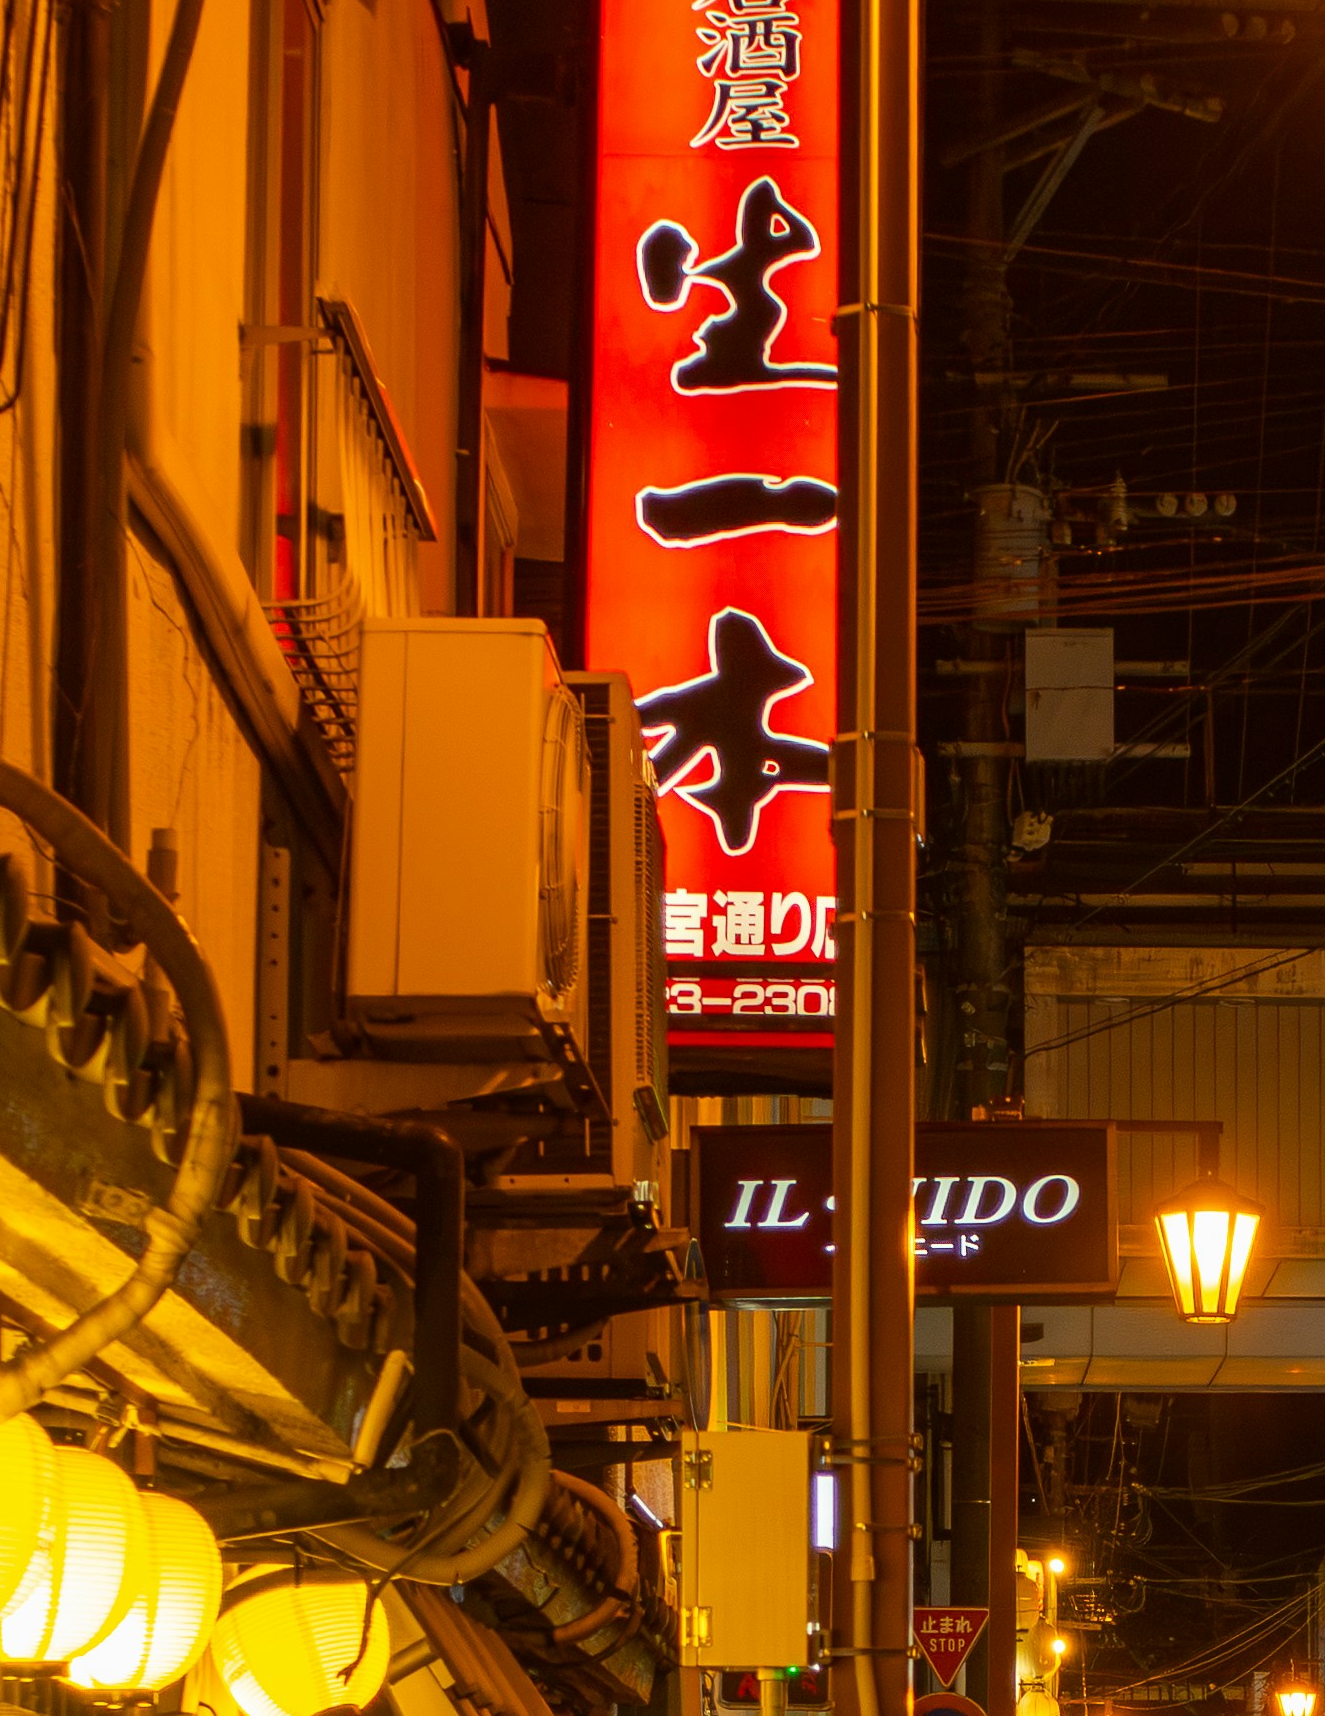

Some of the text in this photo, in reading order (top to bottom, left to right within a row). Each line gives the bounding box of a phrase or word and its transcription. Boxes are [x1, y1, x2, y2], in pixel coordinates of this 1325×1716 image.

[666, 977, 835, 1016] 3-230
[920, 1615, 973, 1634] 止まれ
[929, 1638, 966, 1653] STOP
